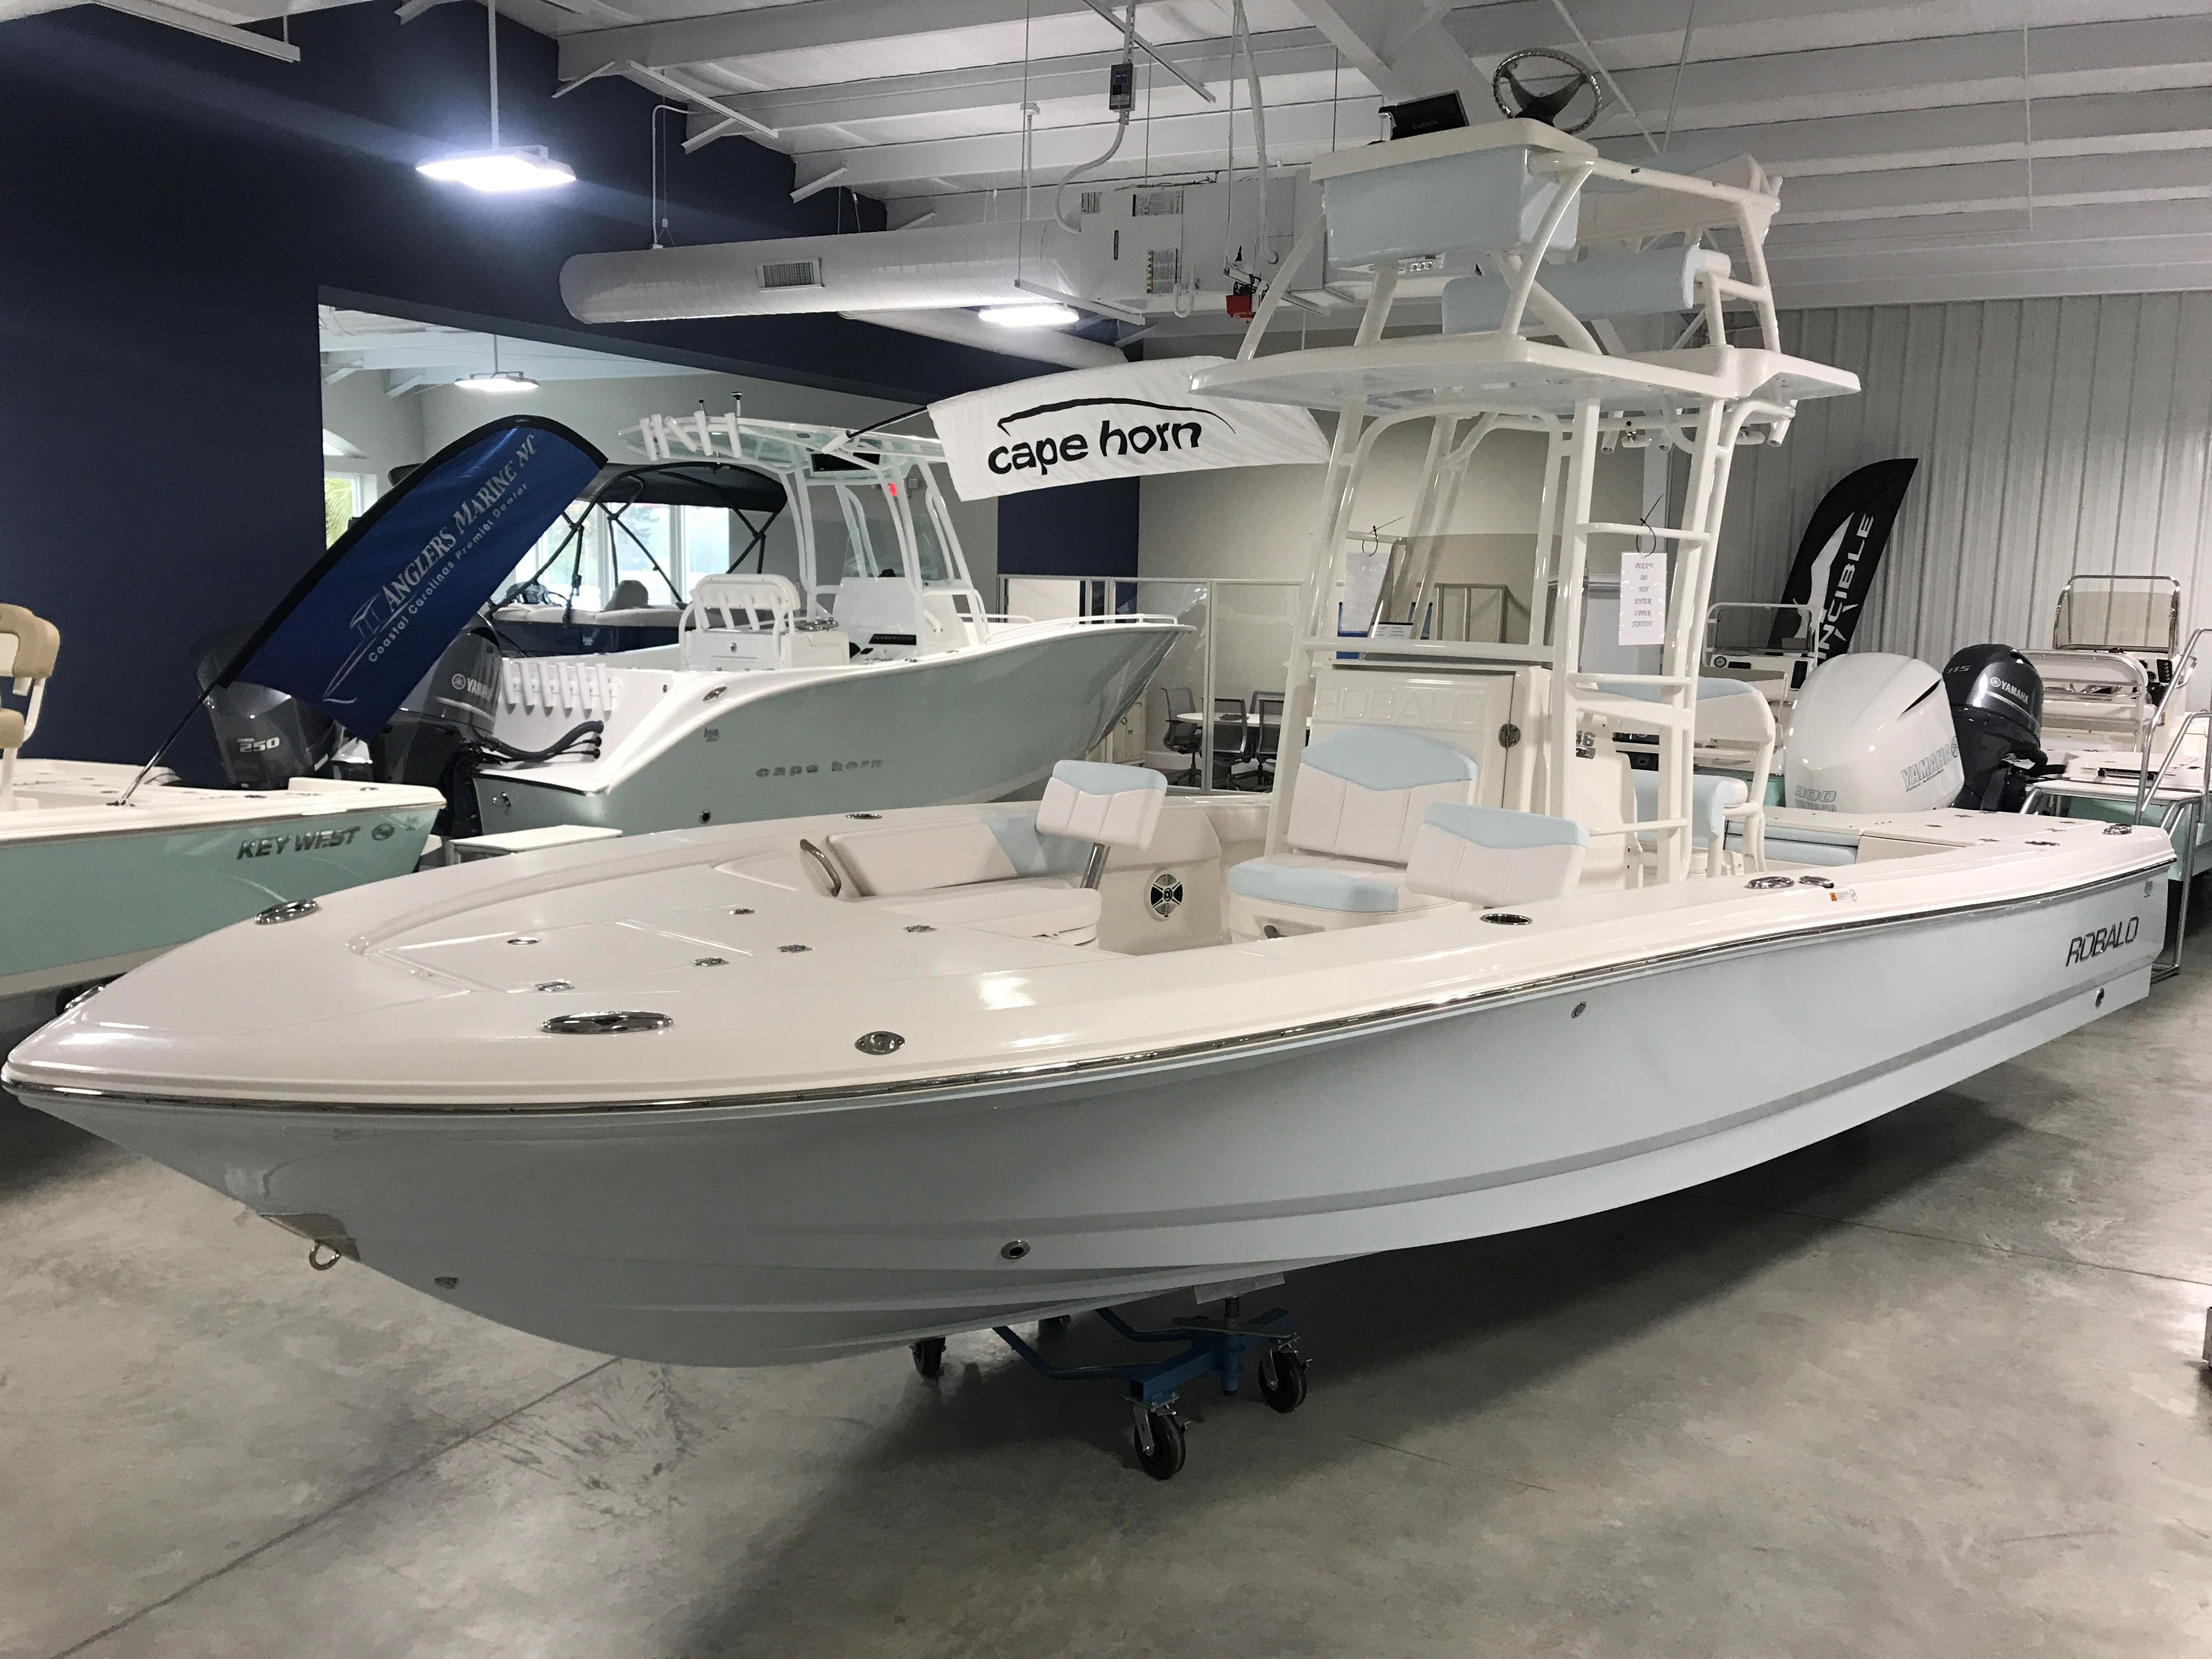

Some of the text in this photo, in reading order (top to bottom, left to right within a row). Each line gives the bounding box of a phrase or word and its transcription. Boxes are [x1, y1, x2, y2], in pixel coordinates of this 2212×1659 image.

[988, 420, 1202, 476] cape horn
[382, 526, 456, 613] ANGLERS
[453, 460, 517, 535] MARINE
[369, 483, 527, 662] Coastal Carolinas Premier Dealer
[2001, 680, 2029, 705] YAMAHA
[239, 736, 280, 753] 250
[755, 763, 819, 777] cape
[1900, 743, 1953, 788] YAMAHA
[1795, 785, 1837, 802] 300
[236, 826, 361, 860] KEY WEST
[2066, 916, 2140, 967] ROBALO
